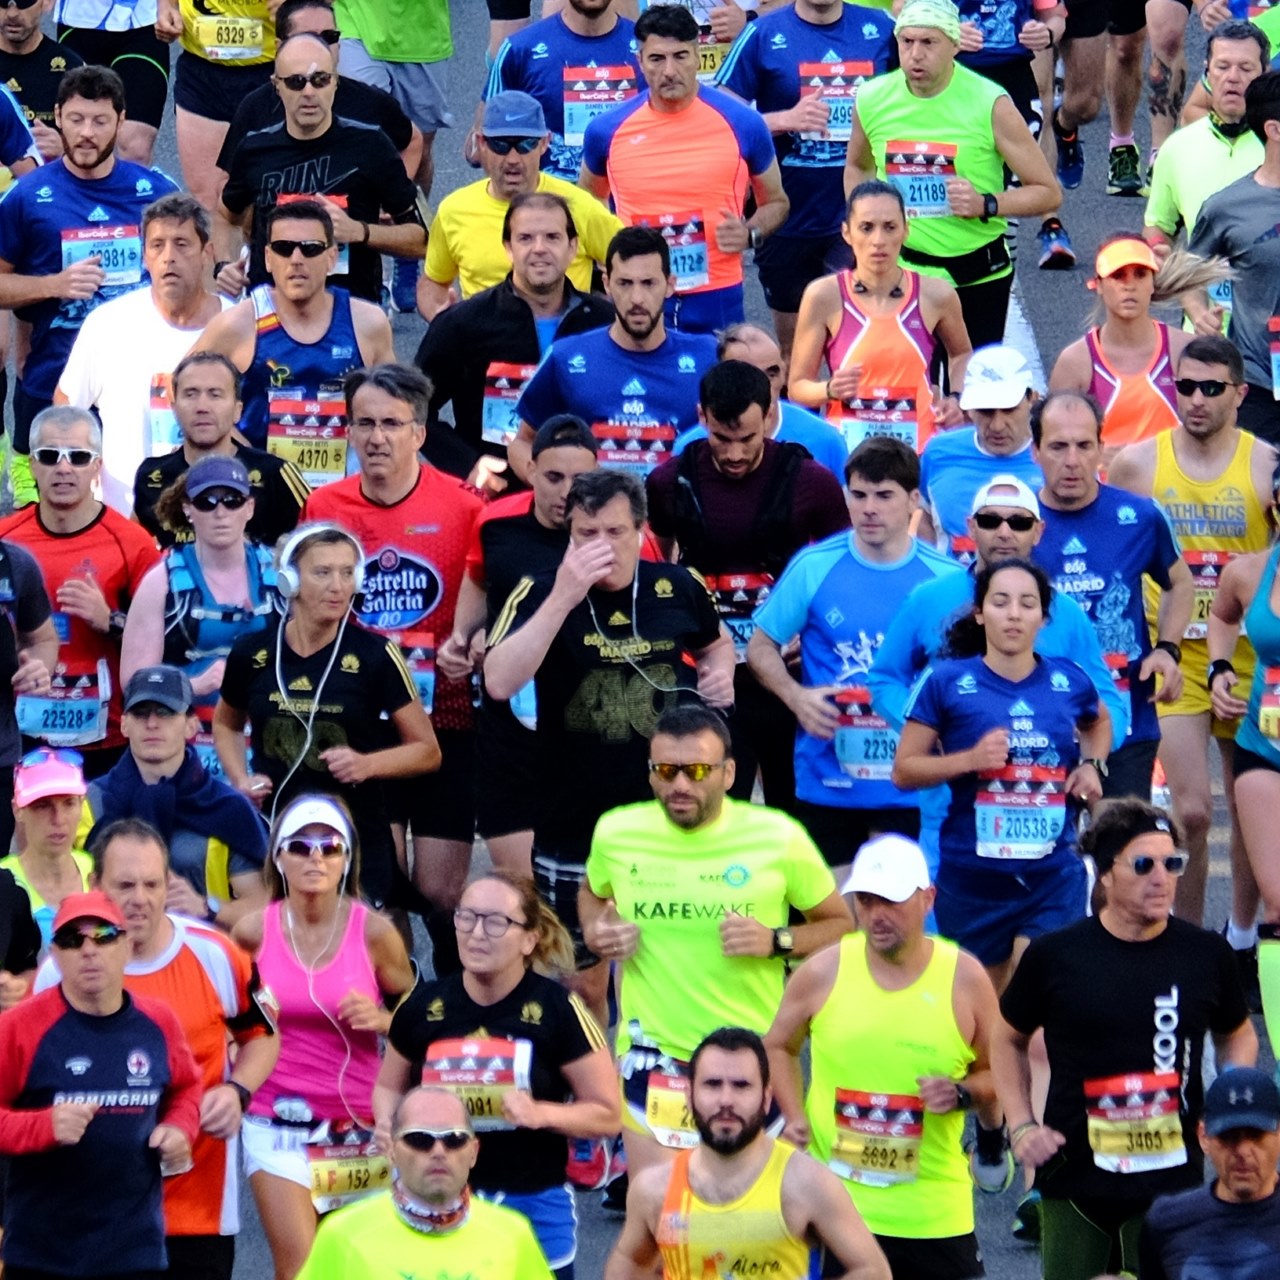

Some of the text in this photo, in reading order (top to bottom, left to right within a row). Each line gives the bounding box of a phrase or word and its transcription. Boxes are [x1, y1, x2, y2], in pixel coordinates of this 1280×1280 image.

[215, 25, 245, 45] 6329
[261, 156, 333, 208] RUN
[909, 174, 947, 195] 21189
[296, 448, 329, 471] 4370
[360, 571, 428, 593] Estrella
[360, 591, 424, 612] Galicia
[41, 707, 84, 730] 22528
[1005, 817, 1051, 839] 20538
[633, 902, 756, 921] KAFEWAKE
[1152, 983, 1180, 1073] KOOL
[345, 1167, 372, 1189] 152
